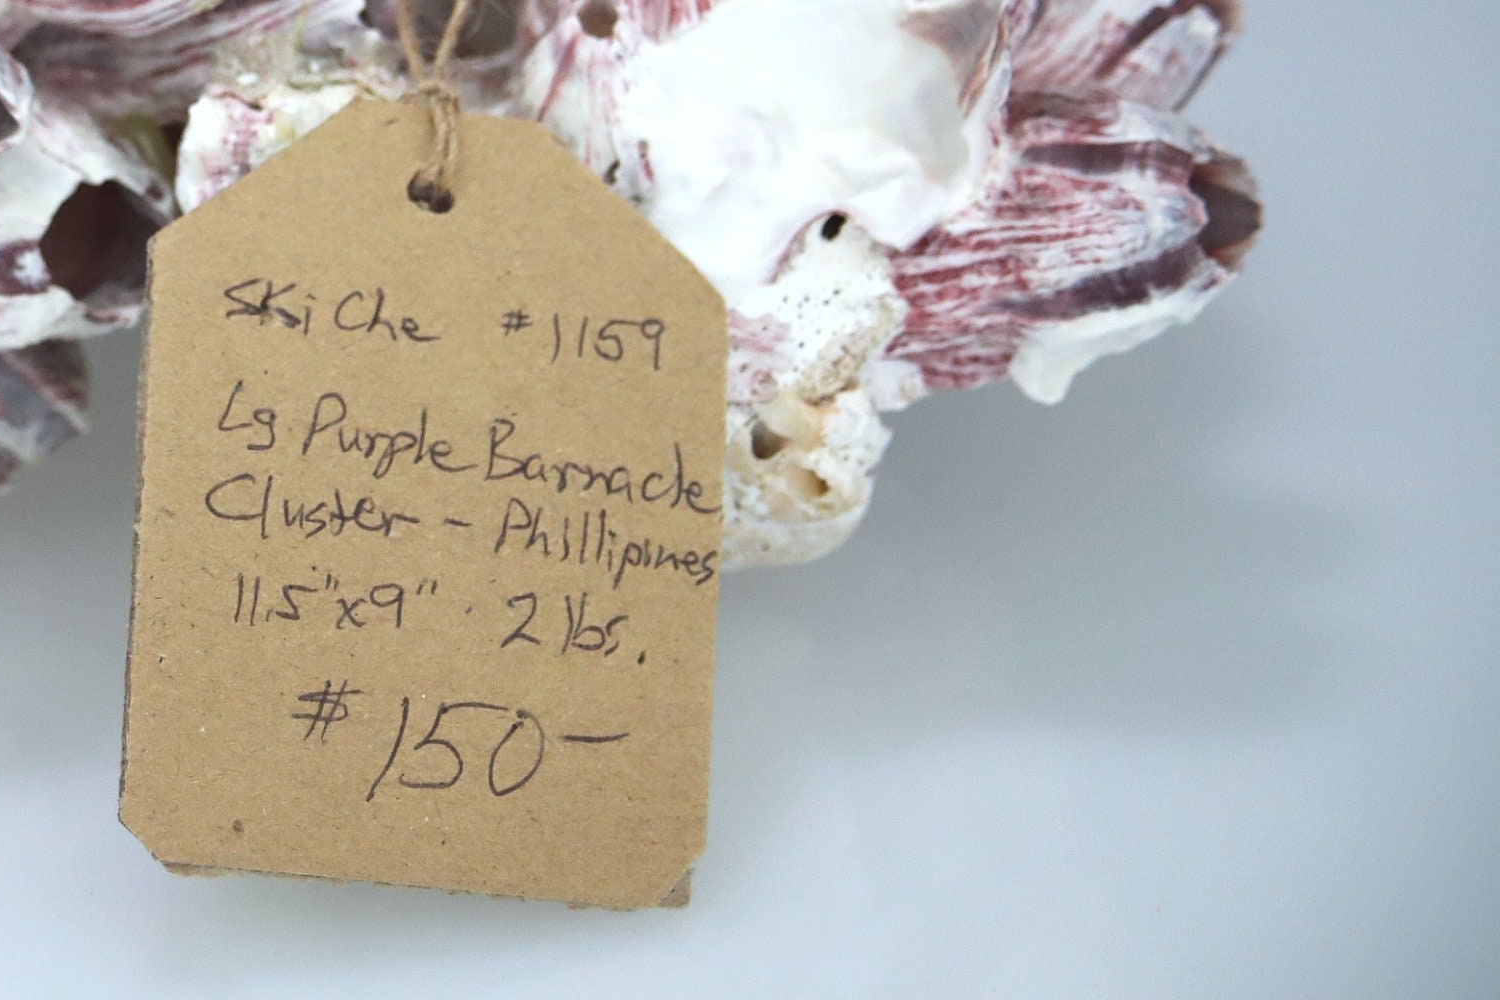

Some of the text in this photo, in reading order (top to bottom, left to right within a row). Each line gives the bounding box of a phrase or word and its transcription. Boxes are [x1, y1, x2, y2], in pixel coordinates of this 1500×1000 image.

[333, 287, 442, 343] Che
[501, 308, 666, 372] #1159
[217, 380, 723, 515] Lg Purple Barnacle
[204, 473, 422, 540] Cluster
[500, 591, 542, 649] 2
